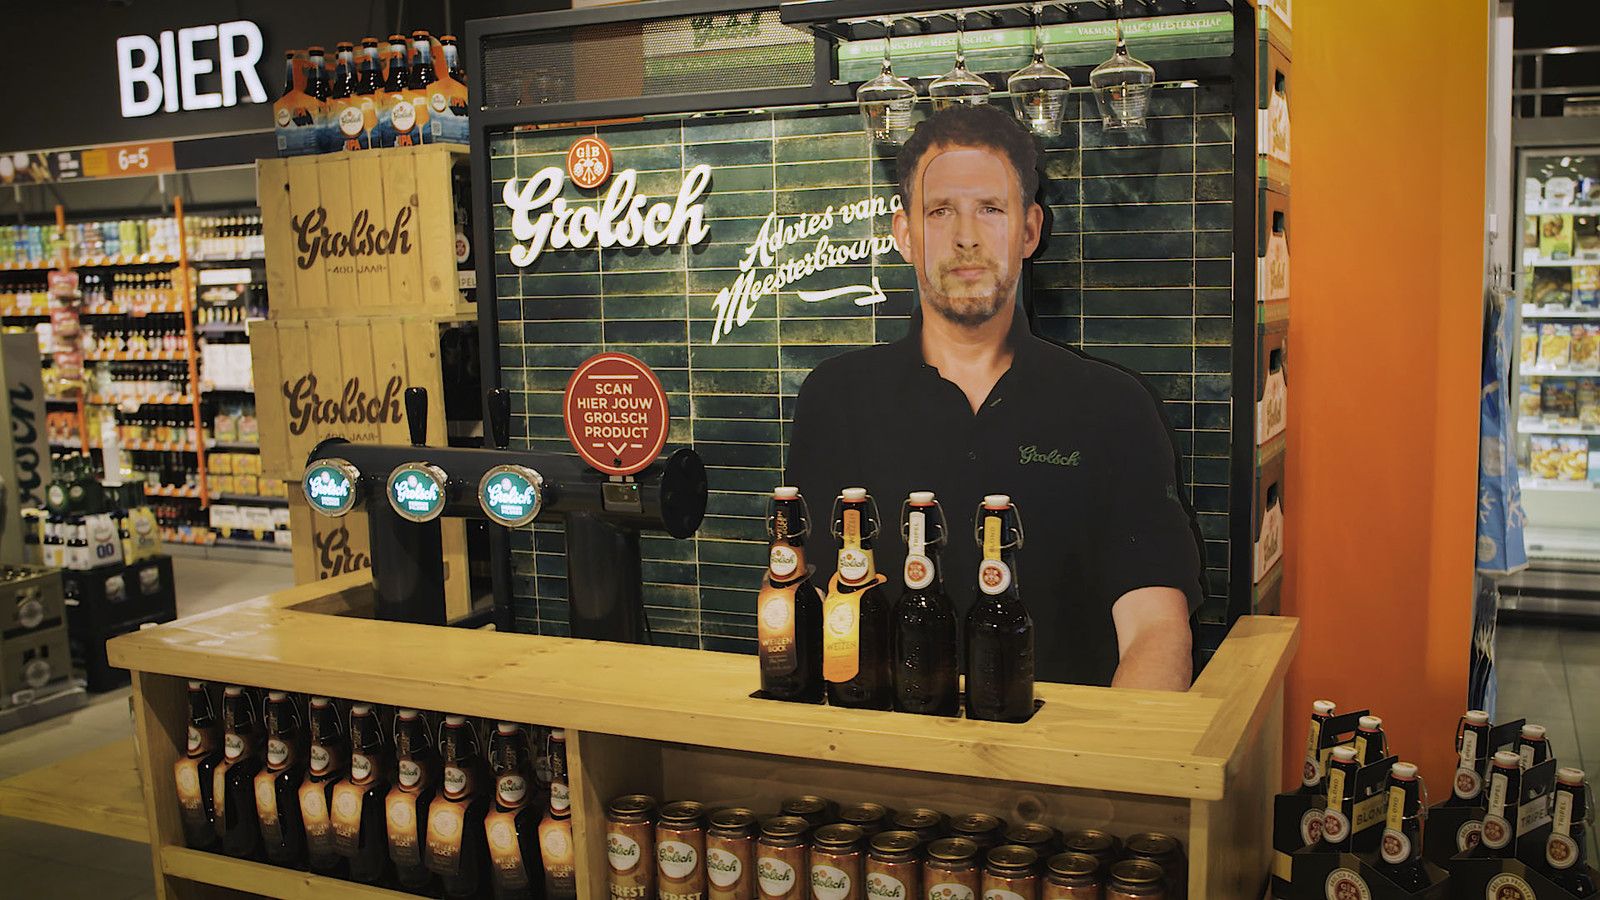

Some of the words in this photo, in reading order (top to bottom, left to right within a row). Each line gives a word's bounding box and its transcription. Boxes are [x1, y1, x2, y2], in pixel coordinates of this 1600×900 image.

[1078, 22, 1141, 36] VAKMANSHAP
[117, 20, 268, 118] BIER
[118, 147, 149, 171] 6=5
[502, 164, 712, 268] Grolsch
[292, 205, 413, 270] Grolsch
[739, 205, 834, 272] Advies
[839, 196, 888, 225] van
[595, 383, 633, 395] SCAN
[283, 373, 403, 436] Grolsch
[577, 398, 608, 409] HIER
[611, 398, 653, 410] JOUW
[584, 412, 648, 424] GROLSCH
[584, 426, 649, 439] PRODUCT
[1018, 445, 1080, 467] Grolsch
[309, 476, 350, 498] Grolsch
[394, 480, 440, 503] Grolsch
[487, 483, 535, 506] Grolsch
[761, 637, 793, 647] WEIZEN
[767, 644, 788, 653] BOCK
[1493, 784, 1501, 808] TRIPEL
[1558, 801, 1566, 827] TRIPEL
[658, 847, 694, 864] Grolsch
[812, 871, 847, 891] Grolsch
